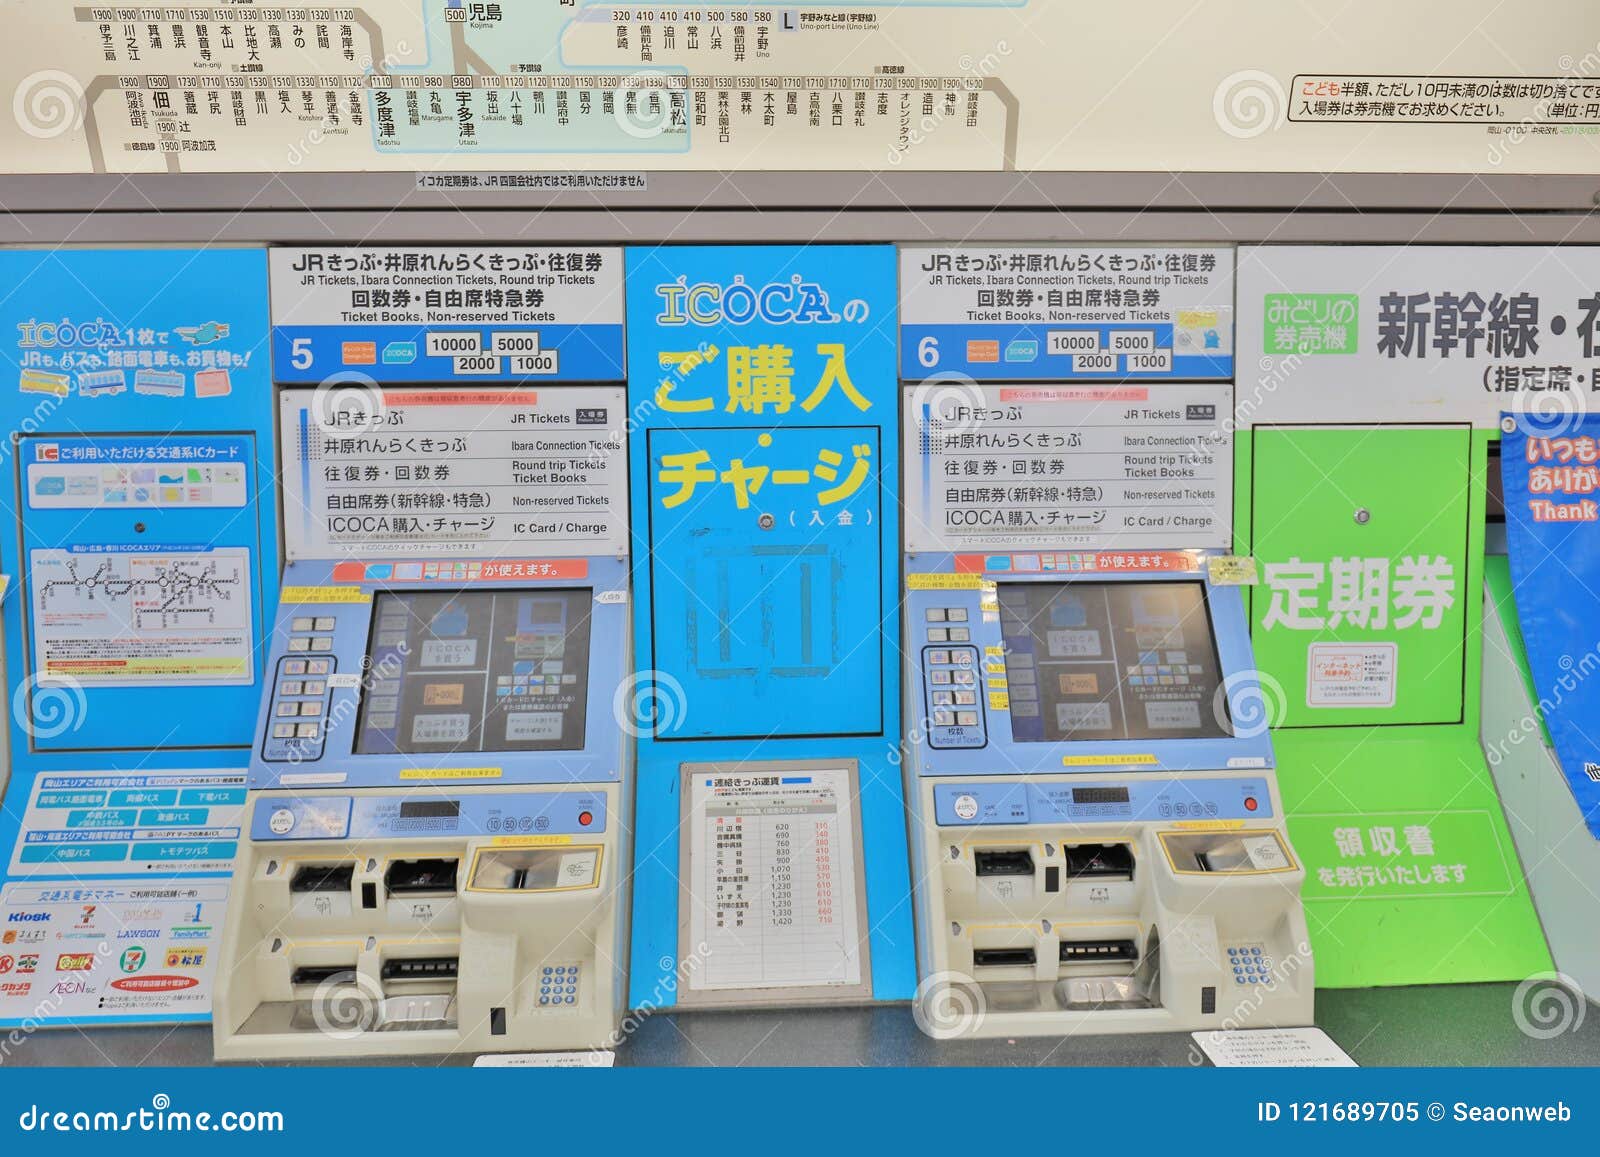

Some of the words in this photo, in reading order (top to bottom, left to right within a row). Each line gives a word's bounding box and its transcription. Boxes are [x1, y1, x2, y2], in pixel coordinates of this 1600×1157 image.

[166, 10, 185, 20] 1710
[311, 10, 330, 20] 1320
[447, 10, 465, 20] 500
[468, 3, 503, 21] 児島
[613, 11, 630, 22] 320
[637, 11, 654, 22] 410
[660, 11, 678, 22] 410
[707, 11, 725, 22] 500
[731, 11, 748, 22] 580
[784, 13, 794, 30] L
[123, 24, 141, 60] 川之江
[220, 25, 234, 49] 本山
[292, 25, 306, 49] みの
[687, 26, 699, 50] 常山
[756, 26, 769, 50] 宇野
[149, 78, 168, 87] 1900
[424, 78, 442, 87] 980
[453, 78, 471, 87] 980
[691, 78, 709, 87] 1530
[784, 78, 801, 88] 1710
[898, 79, 915, 88] 1900
[152, 91, 171, 109] 佃
[486, 90, 499, 114] 坂出
[579, 91, 592, 115] 国分
[877, 92, 889, 115] 志度
[375, 91, 396, 138] 多度津
[455, 91, 475, 138] 宇多津
[669, 92, 687, 126] 高松
[763, 92, 775, 126] 木太町
[1300, 100, 1505, 117] 入場券は券売機でお求めください。
[898, 92, 911, 152] オレンジタウン
[292, 253, 603, 272] JRきっぷ・井原れんらくきっぷ・往復券
[921, 254, 1216, 272] JRきっぷ・井原れんらくきっぷ・往復券
[301, 275, 315, 285] JR
[318, 275, 359, 286] Tickets,
[362, 275, 390, 285] Ibara
[393, 275, 453, 285] Connection
[456, 275, 496, 286] Tickets,
[499, 275, 535, 285] Round
[537, 275, 555, 287] trip
[557, 275, 595, 285] Tickets
[929, 275, 943, 285] JR
[946, 275, 984, 286] Tickets,
[987, 275, 1014, 285] Ibara
[1017, 275, 1074, 285] Connection
[1078, 275, 1116, 286] Tickets,
[1119, 275, 1151, 285] Round
[1154, 275, 1170, 287] trip
[1172, 275, 1209, 285] Tickets
[352, 290, 544, 308] 回数券・自由席特急券
[977, 289, 1160, 307] 回数券・自由席特急券
[341, 311, 377, 322] Ticket
[381, 311, 424, 324] Books,
[427, 311, 510, 322] Non-reserved
[514, 311, 555, 322] Tickets
[967, 310, 1002, 321] Ticket
[1005, 310, 1045, 322] Books,
[1049, 310, 1126, 321] Non-reserved
[1129, 310, 1170, 320] Tickets
[1268, 299, 1355, 324] みどりの
[1053, 337, 1095, 350] 10000
[1115, 336, 1149, 349] 5000
[1274, 325, 1347, 351] 券売機
[432, 339, 476, 351] 10000
[498, 339, 534, 351] 5000
[917, 336, 939, 367] 6
[291, 338, 314, 370] 5
[459, 358, 495, 370] 2000
[517, 358, 552, 370] 1000
[1078, 356, 1112, 368] 2000
[1132, 355, 1166, 367] 1000
[655, 343, 872, 414] ご購入
[324, 410, 405, 426] JRきっぷ
[511, 414, 526, 423] JR
[530, 414, 570, 423] Tickets
[944, 406, 1023, 422] JRきっぷ
[1124, 410, 1138, 419] JR
[1142, 409, 1181, 419] Tickets
[324, 437, 467, 454] 井原れんらくきっぷ
[511, 441, 534, 451] Ibara
[536, 441, 587, 450] Connection
[589, 440, 620, 450] Tickets
[944, 433, 1082, 449] 井原れんらくきっぷ
[1124, 436, 1145, 446] Ibara
[1147, 436, 1195, 446] Connection
[512, 460, 546, 470] Round
[549, 460, 566, 471] trip
[570, 460, 606, 470] Tickets
[1124, 456, 1156, 465] Round
[1160, 455, 1175, 466] trip
[324, 465, 450, 481] 往復券・回数券
[944, 460, 1065, 476] 往復券・回数券
[1125, 468, 1157, 477] Ticket
[1160, 468, 1194, 477] Books
[513, 474, 547, 483] Ticket
[551, 474, 587, 483] Books
[658, 444, 871, 509] チャージ
[513, 496, 574, 506] Non-reserved
[577, 496, 609, 505] Tickets
[1124, 490, 1182, 500] Non-reserved
[1185, 489, 1215, 499] Tickets
[1530, 500, 1597, 521] Thank
[514, 524, 525, 533] IC
[529, 523, 556, 533] Card
[566, 523, 607, 534] Charge
[1124, 517, 1135, 526] IC
[1139, 517, 1164, 526] Card
[1174, 517, 1212, 527] Charge
[1099, 555, 1170, 569] が使えます。
[484, 563, 559, 577] が使えます。
[1262, 555, 1456, 632] 定期券
[1333, 825, 1436, 858] 領収書
[1317, 864, 1468, 888] を発行いたします
[8, 912, 51, 922] Kiosk
[117, 929, 160, 938] LAWSON
